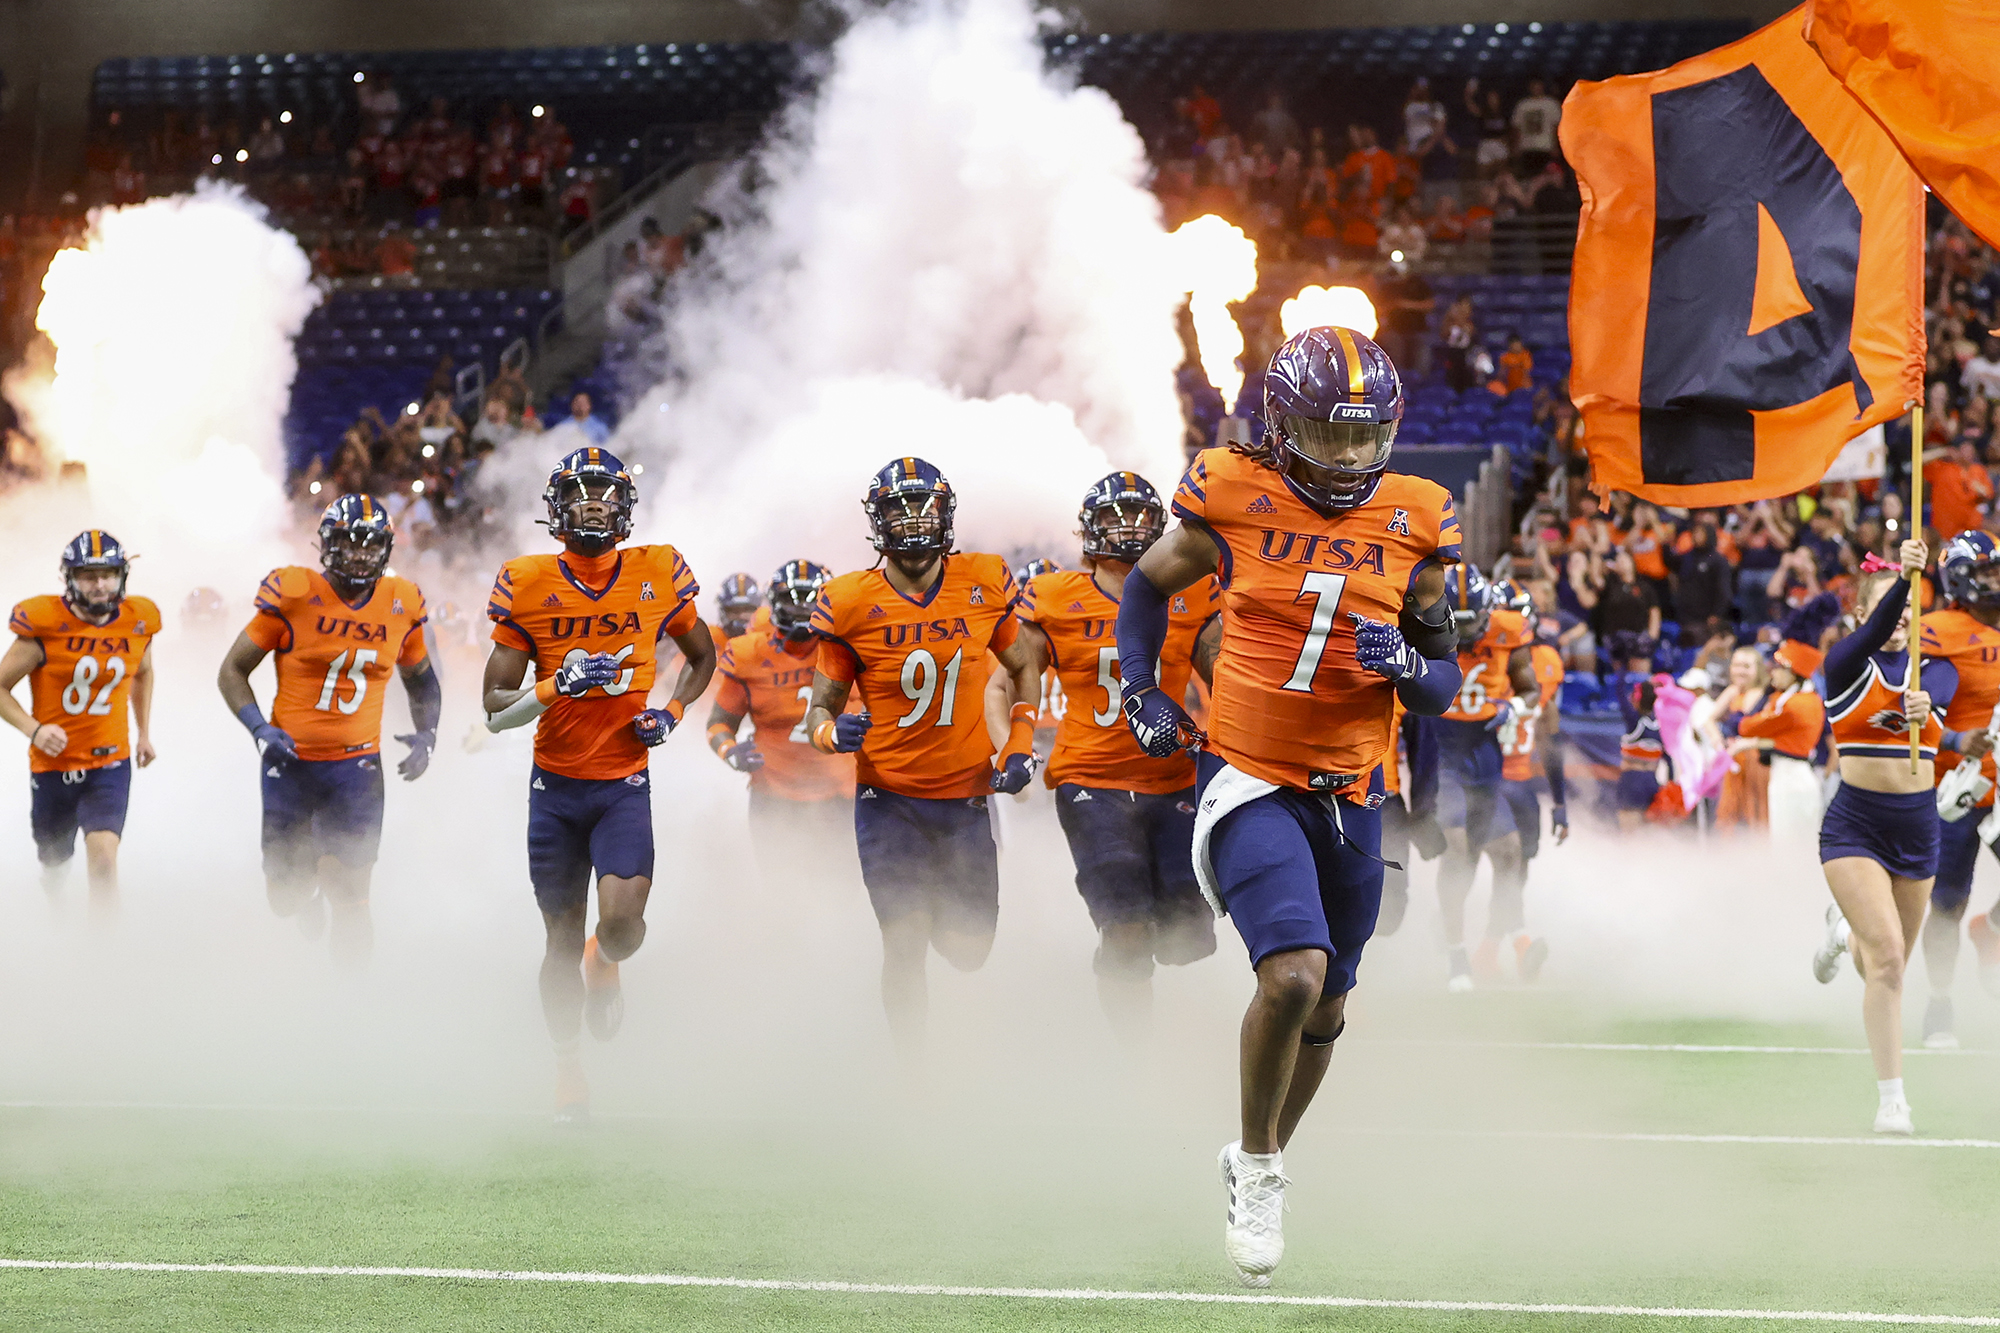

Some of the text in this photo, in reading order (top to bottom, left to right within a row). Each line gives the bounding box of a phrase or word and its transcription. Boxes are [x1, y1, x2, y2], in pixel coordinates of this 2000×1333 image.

[1341, 408, 1372, 419] UTSA
[583, 464, 606, 472] UTSA
[902, 478, 925, 487] UTSA
[1120, 490, 1142, 498] UTSA
[1245, 503, 1278, 514] adidas
[1330, 493, 1354, 501] Riddell
[1258, 529, 1386, 577] UTSA
[316, 616, 387, 643] UTSA
[550, 611, 642, 639] UTSA
[882, 617, 972, 648] UTSA
[1278, 570, 1349, 695] 7
[66, 636, 131, 654] UTSA
[60, 655, 126, 717] 82
[313, 647, 379, 716] 15
[897, 644, 963, 728] 91
